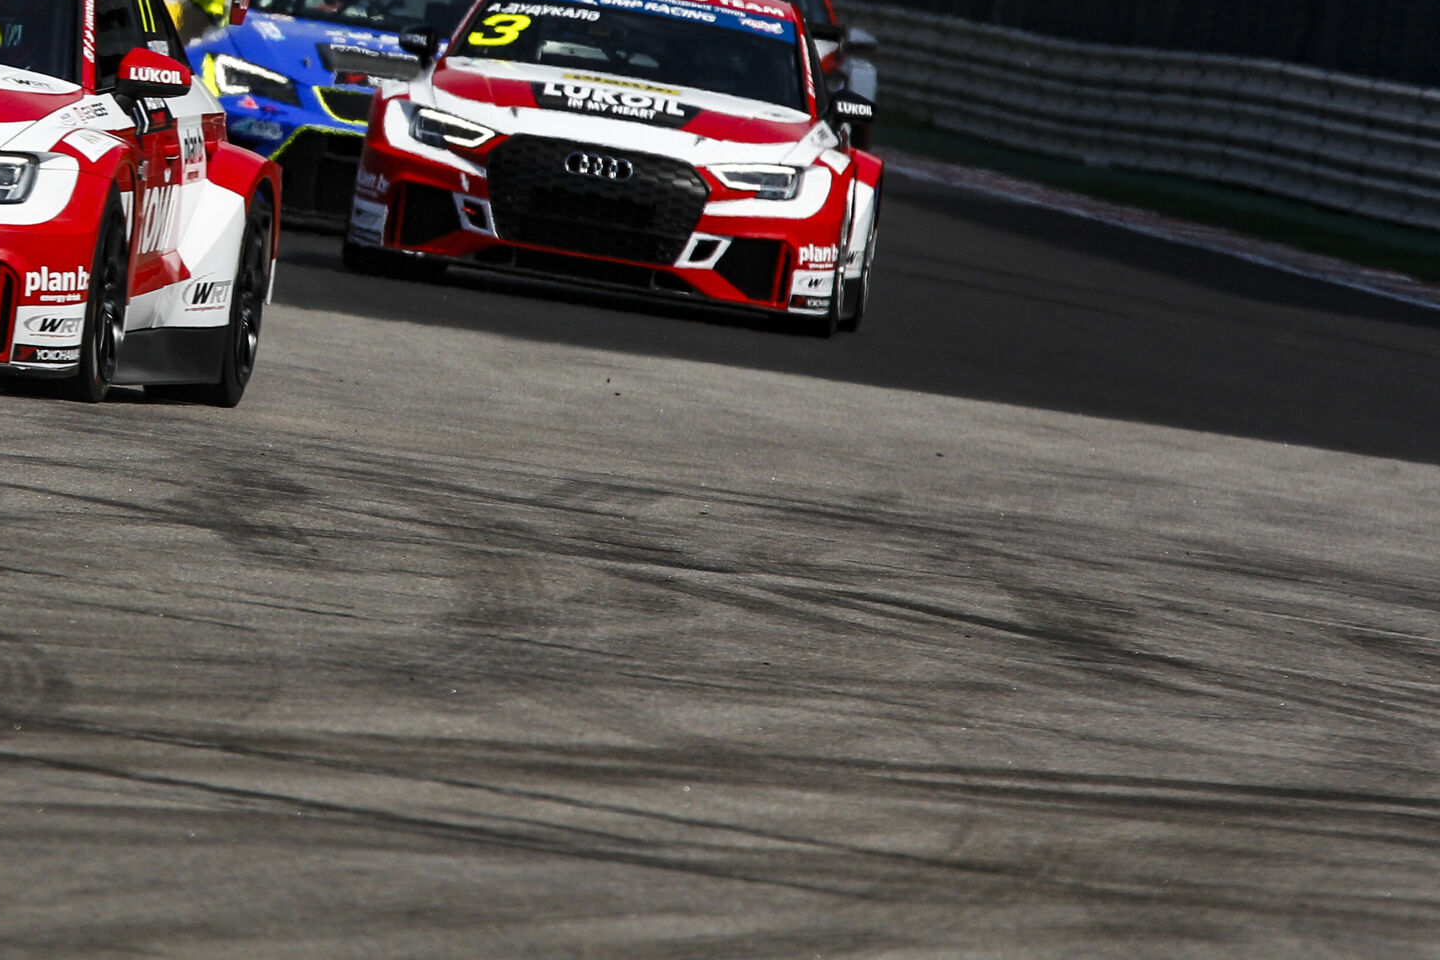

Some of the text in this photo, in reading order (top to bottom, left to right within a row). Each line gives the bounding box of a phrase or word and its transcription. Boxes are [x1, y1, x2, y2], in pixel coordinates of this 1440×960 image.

[468, 13, 531, 46] 3
[129, 66, 183, 85] LUKOIL
[543, 82, 685, 117] LUKOIL
[567, 98, 656, 120] IN MY HEART
[837, 101, 873, 117] LUKOIL
